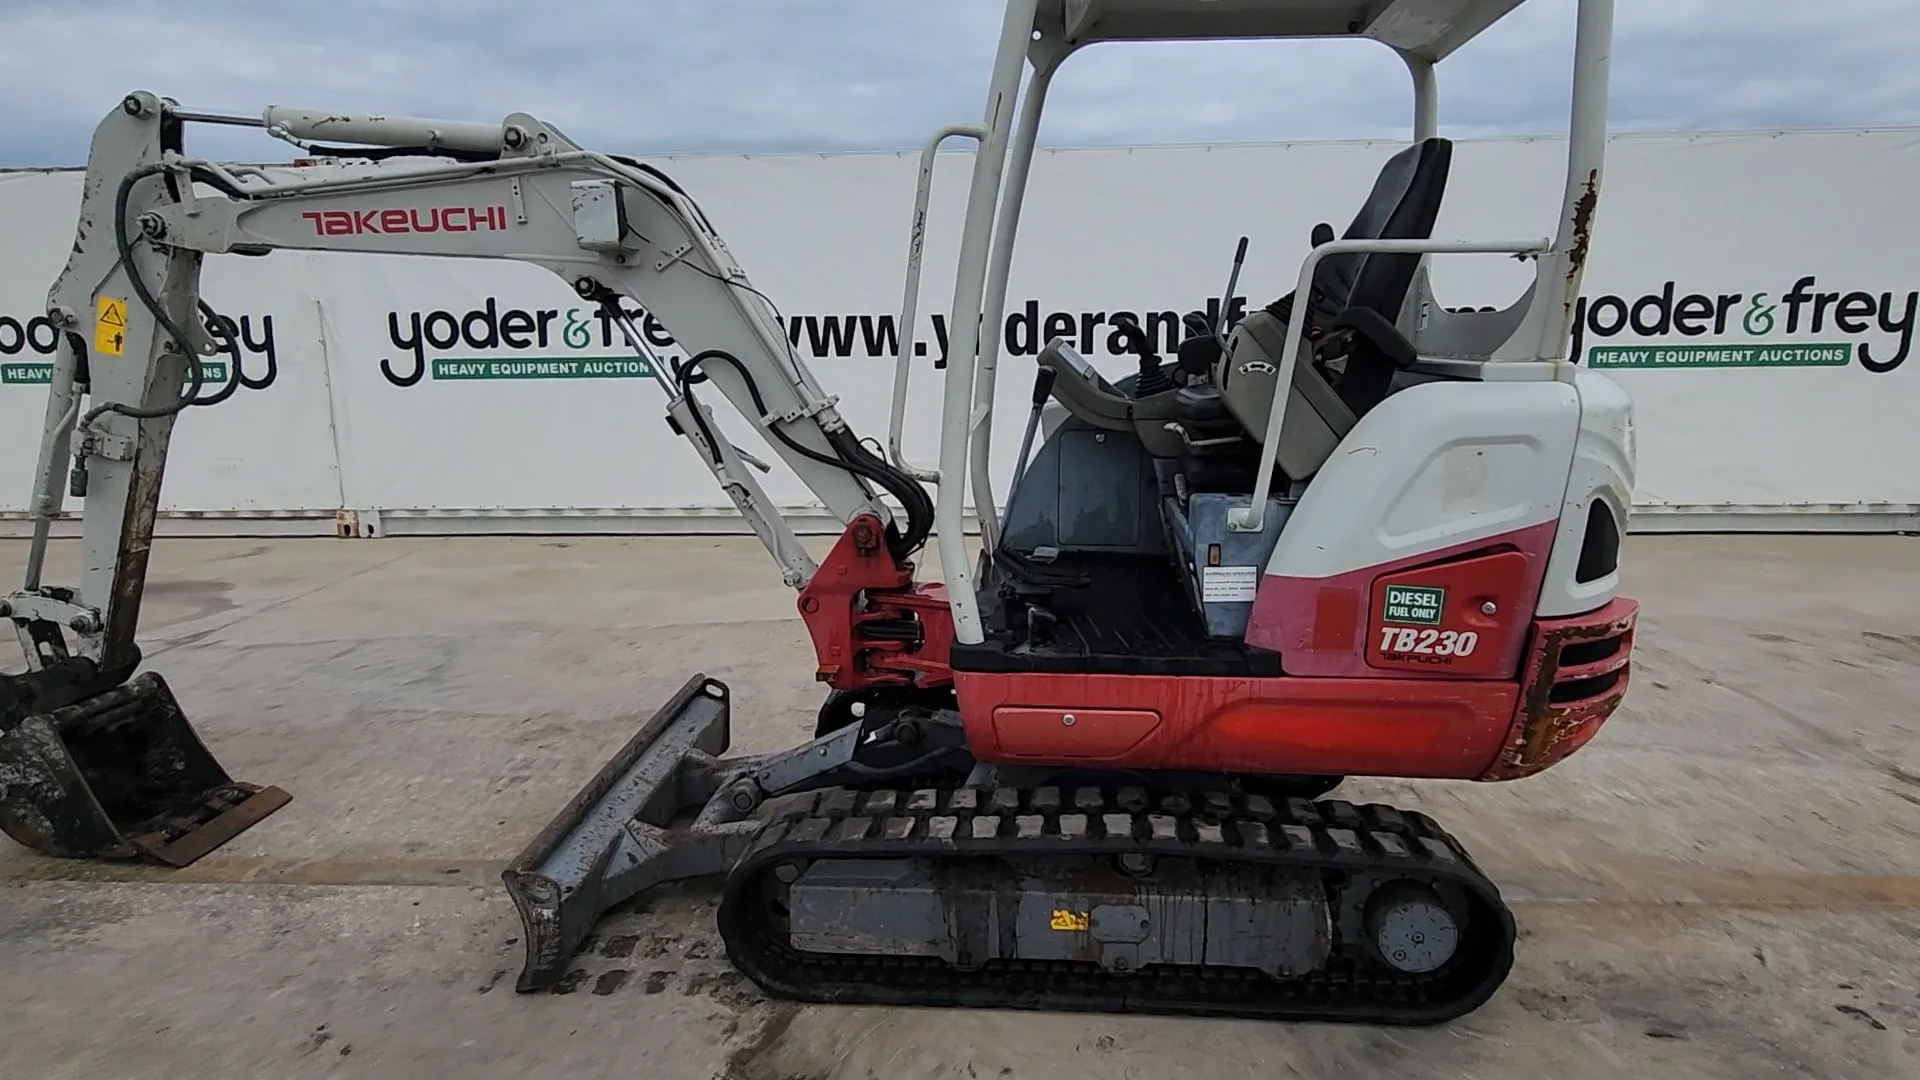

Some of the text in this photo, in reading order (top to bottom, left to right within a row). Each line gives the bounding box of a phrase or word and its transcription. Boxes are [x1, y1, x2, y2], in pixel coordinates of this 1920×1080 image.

[302, 206, 507, 236] TAKEUCHI
[1595, 349, 1844, 364] HEAVY EQUIPMENT AUCTIONS
[7, 367, 52, 379] HEAVY
[438, 361, 649, 376] HEAVY EQUIPMENT AUCTION
[1389, 591, 1438, 607] DIESEL
[1388, 606, 1436, 619] FUEL ONLY
[1380, 627, 1478, 656] TB230
